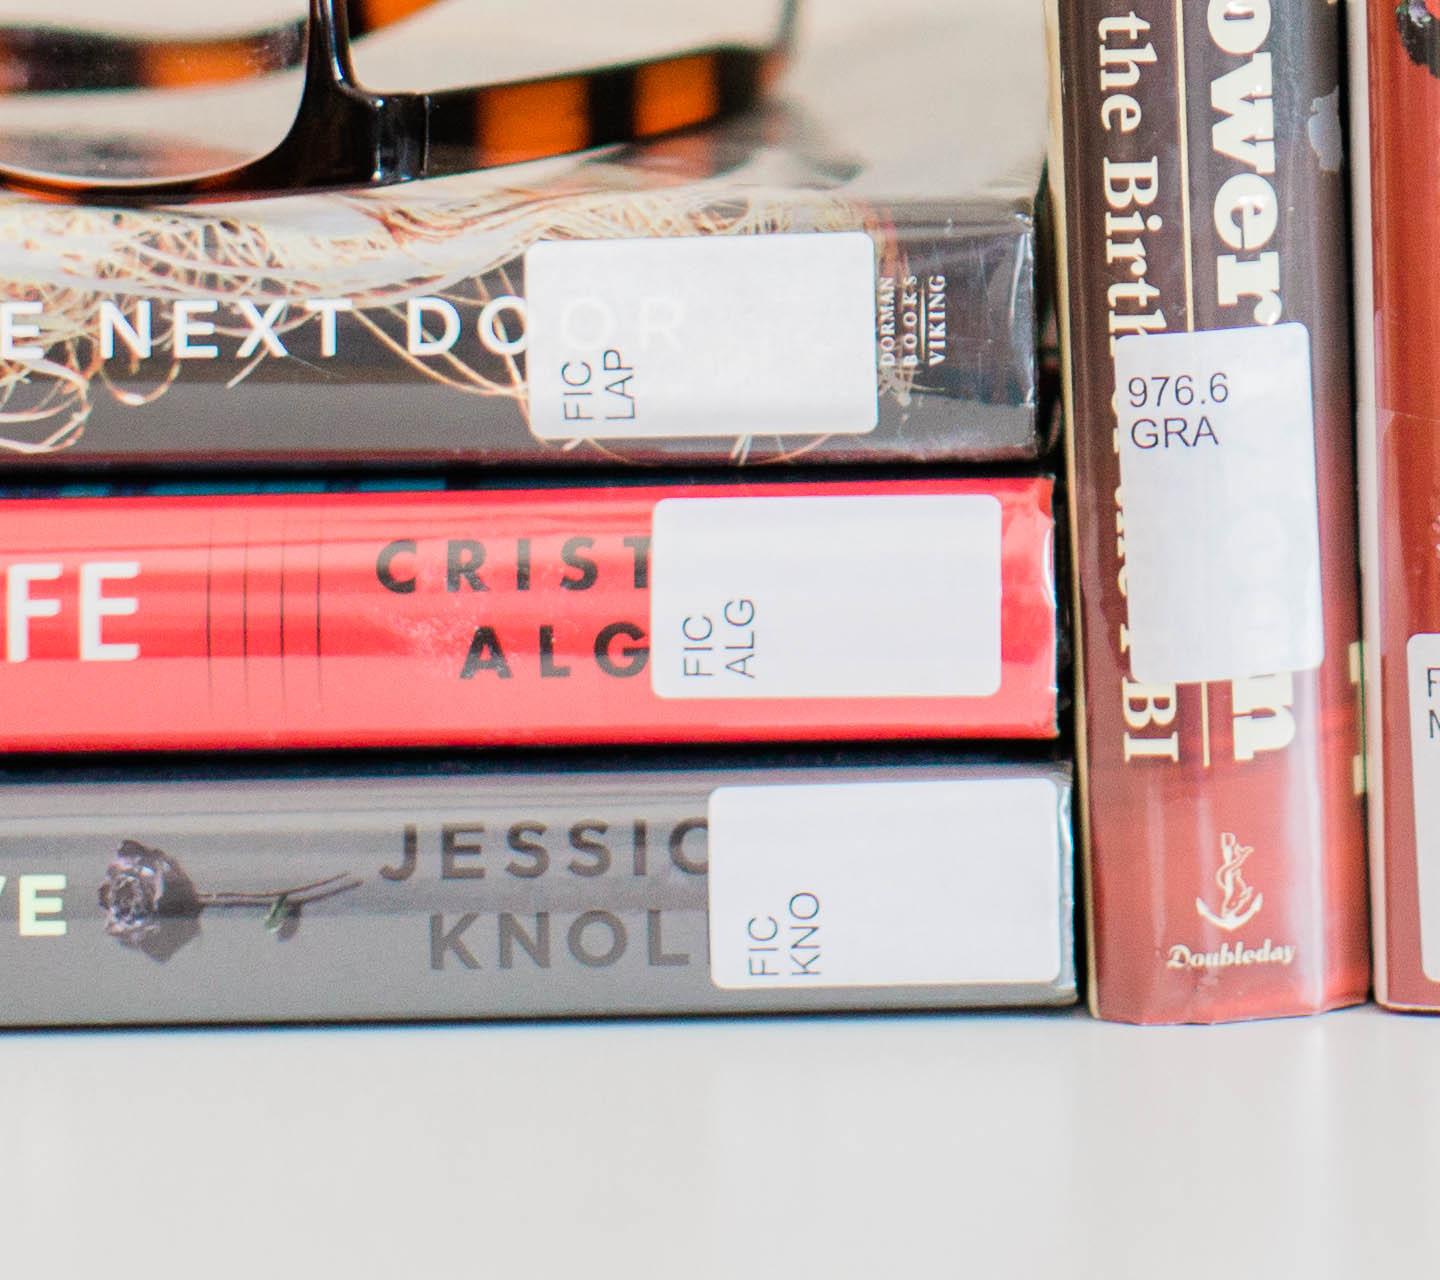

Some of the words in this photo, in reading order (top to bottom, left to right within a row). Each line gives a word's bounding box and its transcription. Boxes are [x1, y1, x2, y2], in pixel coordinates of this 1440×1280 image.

[1097, 10, 1156, 133] the
[100, 299, 351, 358] NEXT
[880, 276, 895, 366] DORMAN
[903, 275, 918, 367] BOOKS
[928, 275, 946, 367] VIKING
[561, 359, 596, 422] FIC
[604, 349, 637, 419] LAP
[1128, 373, 1229, 408] 976.6
[1131, 417, 1219, 449] GRA
[376, 535, 651, 595] CRIST
[459, 623, 650, 679] ALG
[682, 613, 713, 679] FIC
[725, 597, 755, 678] ALG
[379, 817, 710, 882] JESSIC
[430, 906, 710, 972] KNOL
[749, 915, 779, 977] FIC
[789, 892, 820, 977] KNO
[1166, 939, 1295, 968] Doubleday
